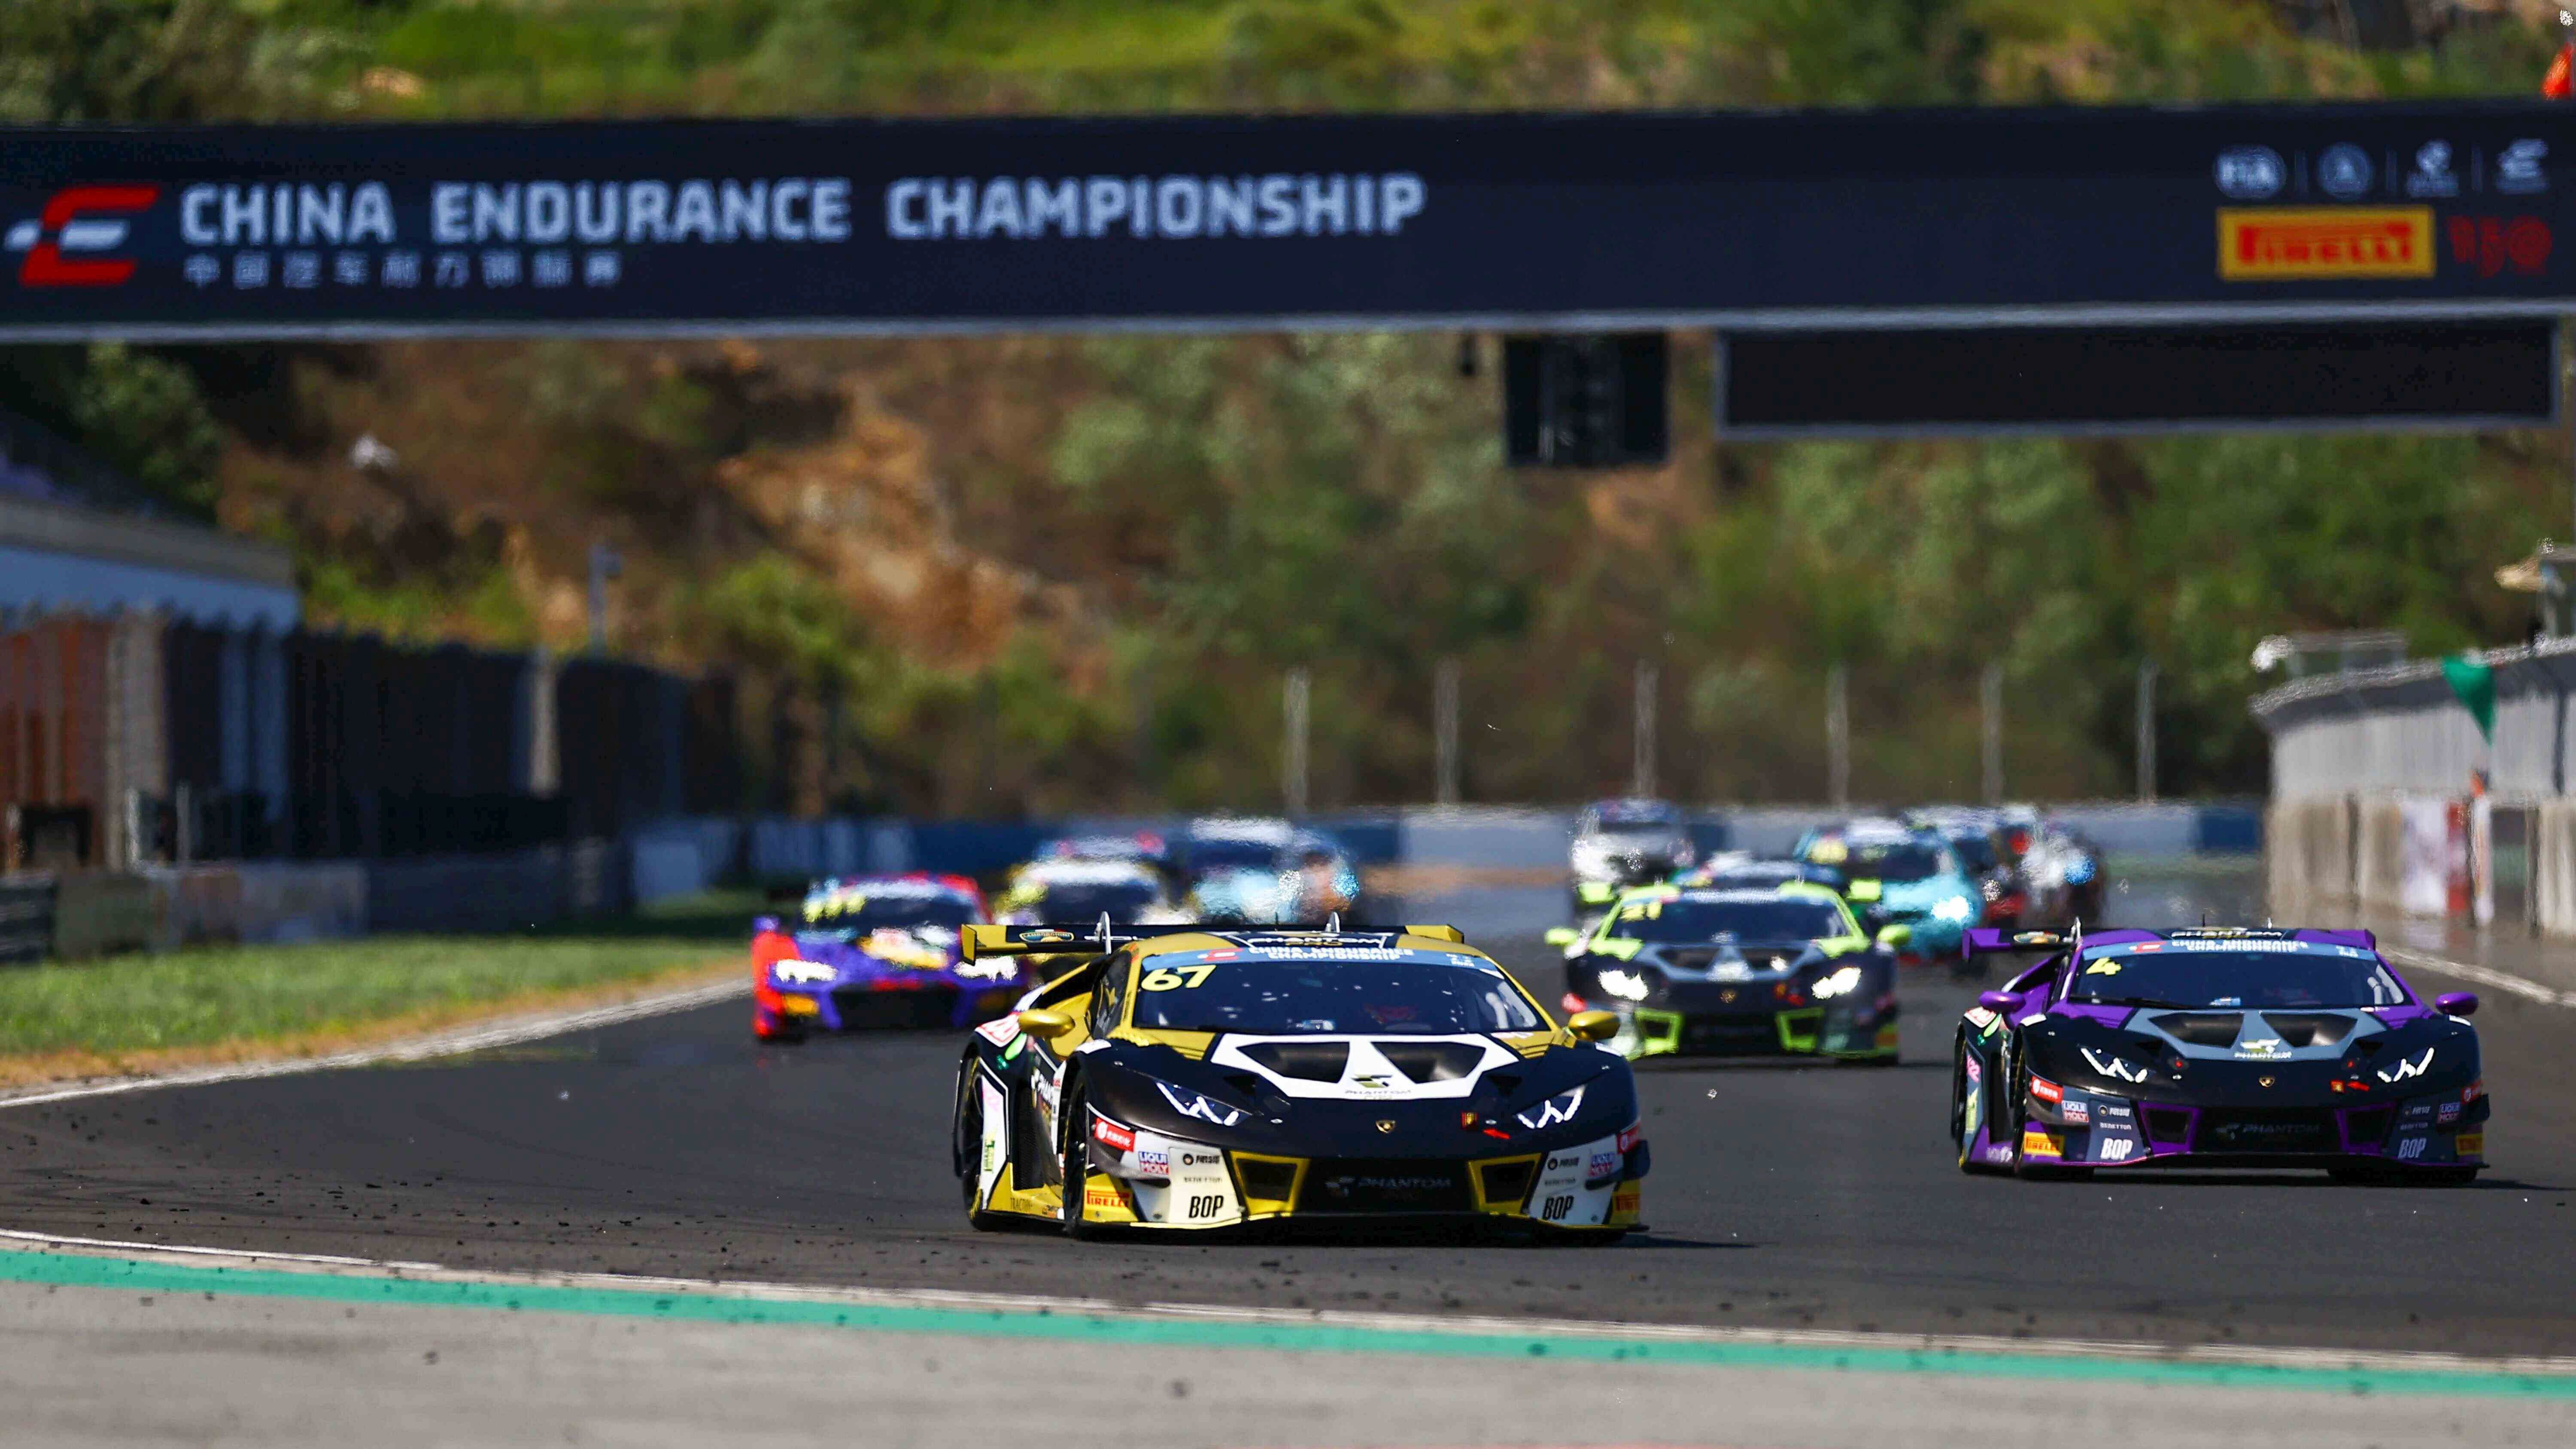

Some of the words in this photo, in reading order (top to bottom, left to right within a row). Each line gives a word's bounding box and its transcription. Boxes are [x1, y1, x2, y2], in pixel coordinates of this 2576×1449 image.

[181, 181, 396, 246] CHINA
[431, 179, 851, 245] ENDURANCE
[885, 173, 1426, 240] CHAMPIONSHIP
[1141, 964, 1217, 991] 67
[2234, 1051, 2292, 1060] PHANTOM
[2062, 1100, 2088, 1113] LIQUI
[1139, 1151, 1168, 1164] LIQUI
[2100, 1137, 2133, 1160] BOP
[2398, 1138, 2427, 1159] BOP
[1087, 1190, 1129, 1208] PIRELLI
[1188, 1195, 1224, 1218] BOP
[1542, 1195, 1574, 1221] BOP
